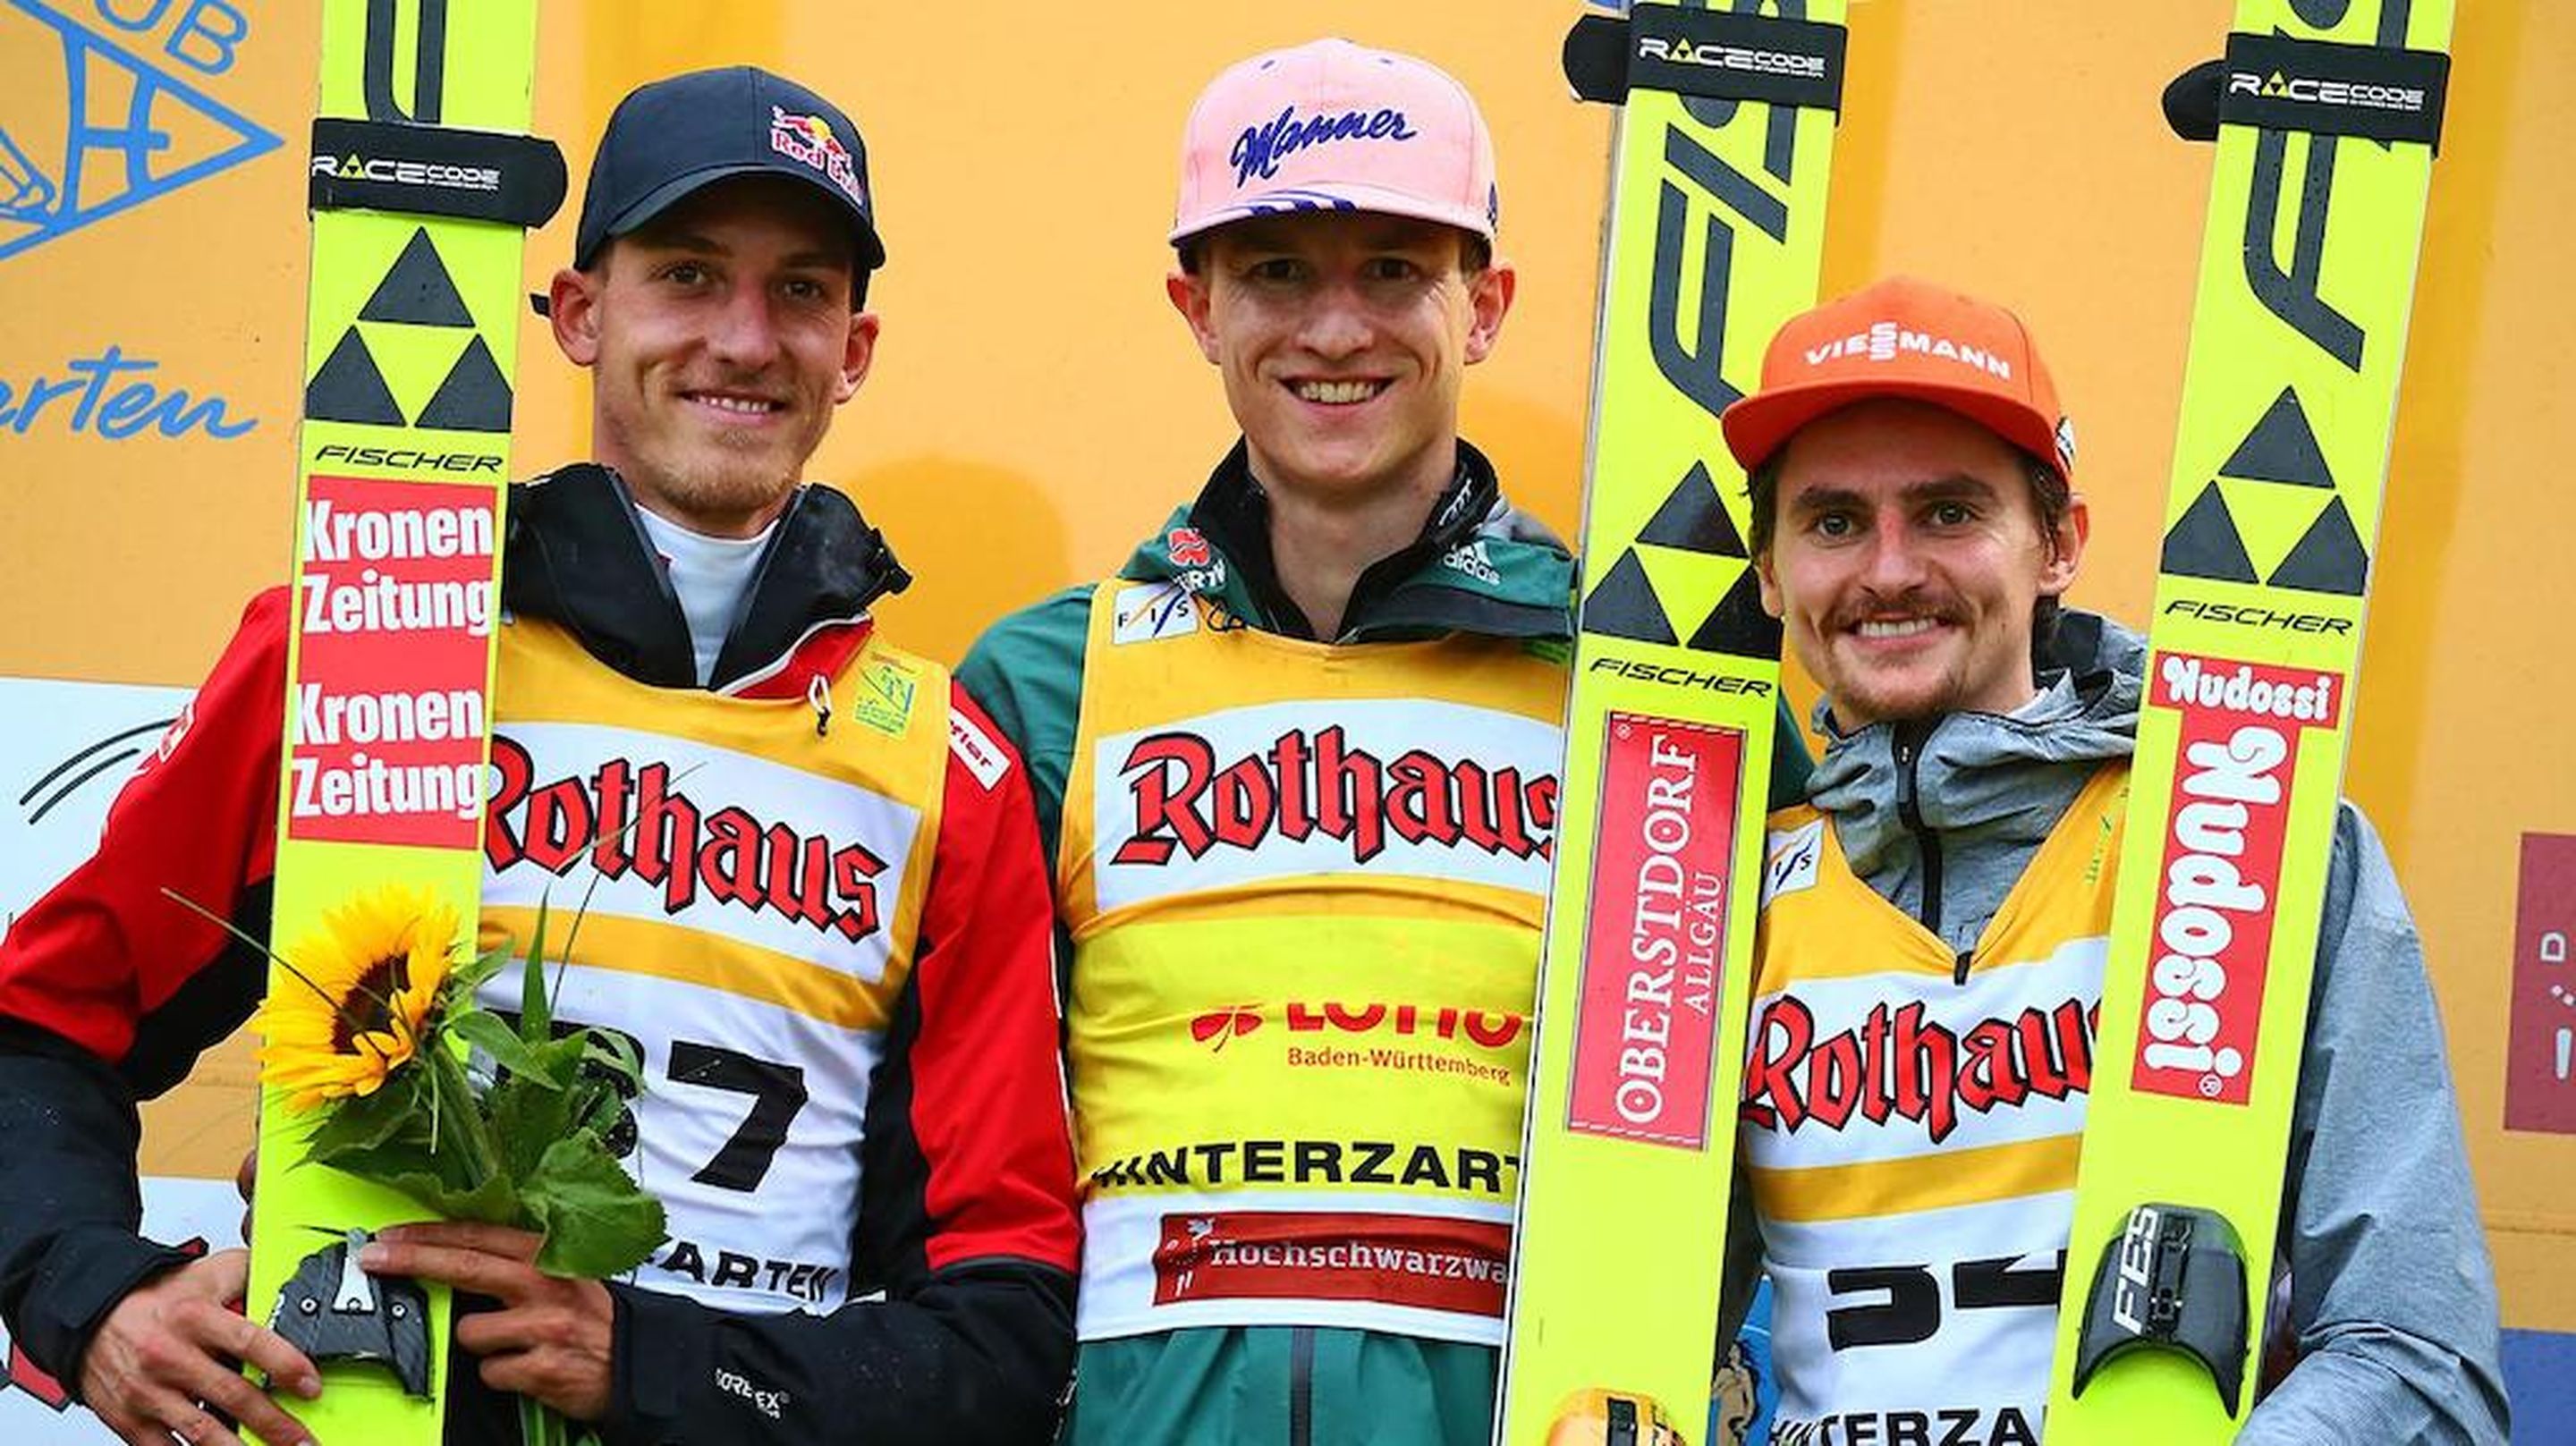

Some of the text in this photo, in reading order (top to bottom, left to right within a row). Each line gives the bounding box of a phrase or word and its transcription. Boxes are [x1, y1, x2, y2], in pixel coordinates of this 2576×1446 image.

[772, 129, 824, 170] Red
[1230, 106, 1418, 189] Manner
[1806, 322, 2011, 379] VIESSMANN
[316, 444, 503, 473] FISCHER
[302, 499, 494, 562] Kronen
[301, 569, 495, 637] Zeitung
[2164, 599, 2352, 637] FISCHER
[1589, 658, 1772, 698] FISCHER
[2162, 655, 2333, 721] Nudossi
[292, 683, 485, 746] Kronen
[291, 751, 488, 821] Zeitung
[1110, 724, 1557, 864] Rothaus
[485, 733, 890, 943] Rothaus
[1614, 733, 1698, 1124] OBERSTDORF
[2143, 725, 2288, 1078] Nudossi
[1683, 872, 1723, 1014] ALLGÄU
[1288, 1046, 1511, 1087] Baden-Württemberg
[1742, 994, 2102, 1144] Rothau
[646, 1239, 839, 1303] ARTEN
